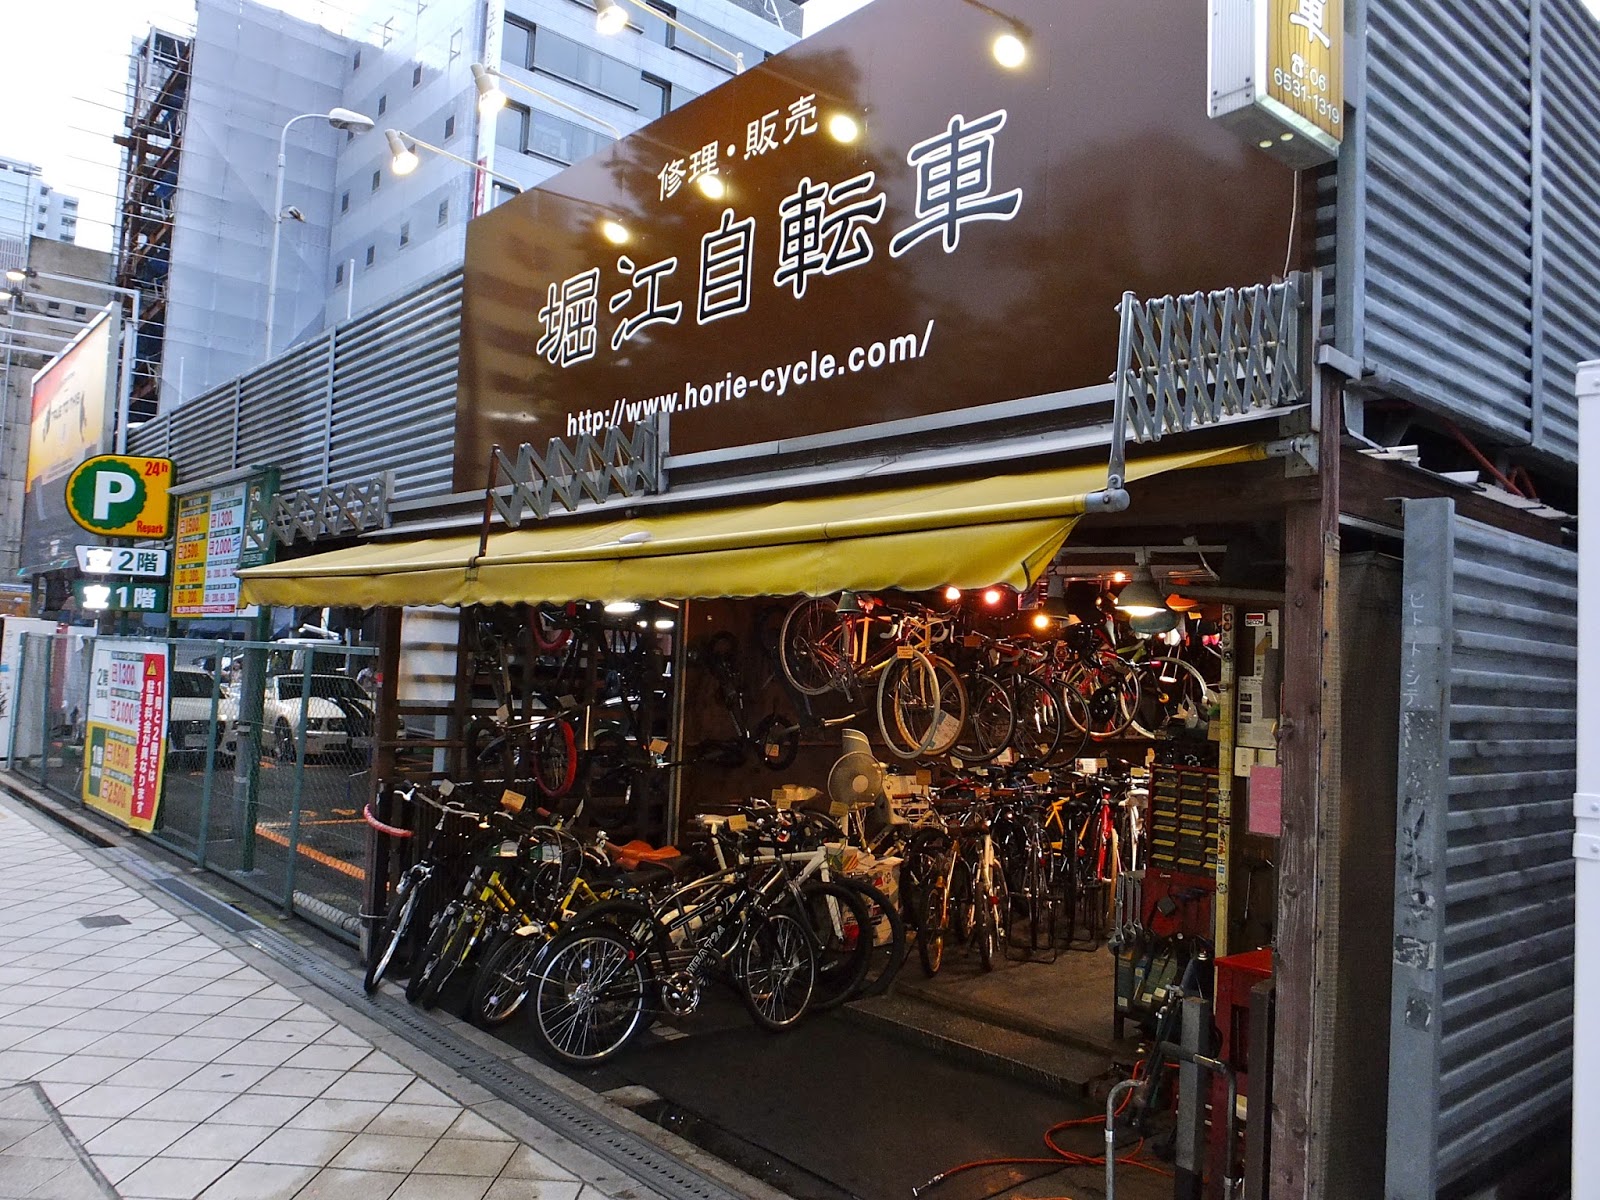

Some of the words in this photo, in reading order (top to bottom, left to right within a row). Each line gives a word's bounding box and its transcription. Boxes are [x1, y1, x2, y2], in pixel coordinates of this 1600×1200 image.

[1273, 67, 1340, 124] 6531-1319
[658, 93, 818, 201] 修理・販売
[535, 108, 1023, 368] 堀江自転車
[566, 319, 934, 437] http://www.horie-cycle.com/
[92, 470, 136, 520] P
[145, 460, 169, 477] 24h
[136, 520, 164, 535] Repark
[136, 680, 155, 814] 駐車料金が異なります
